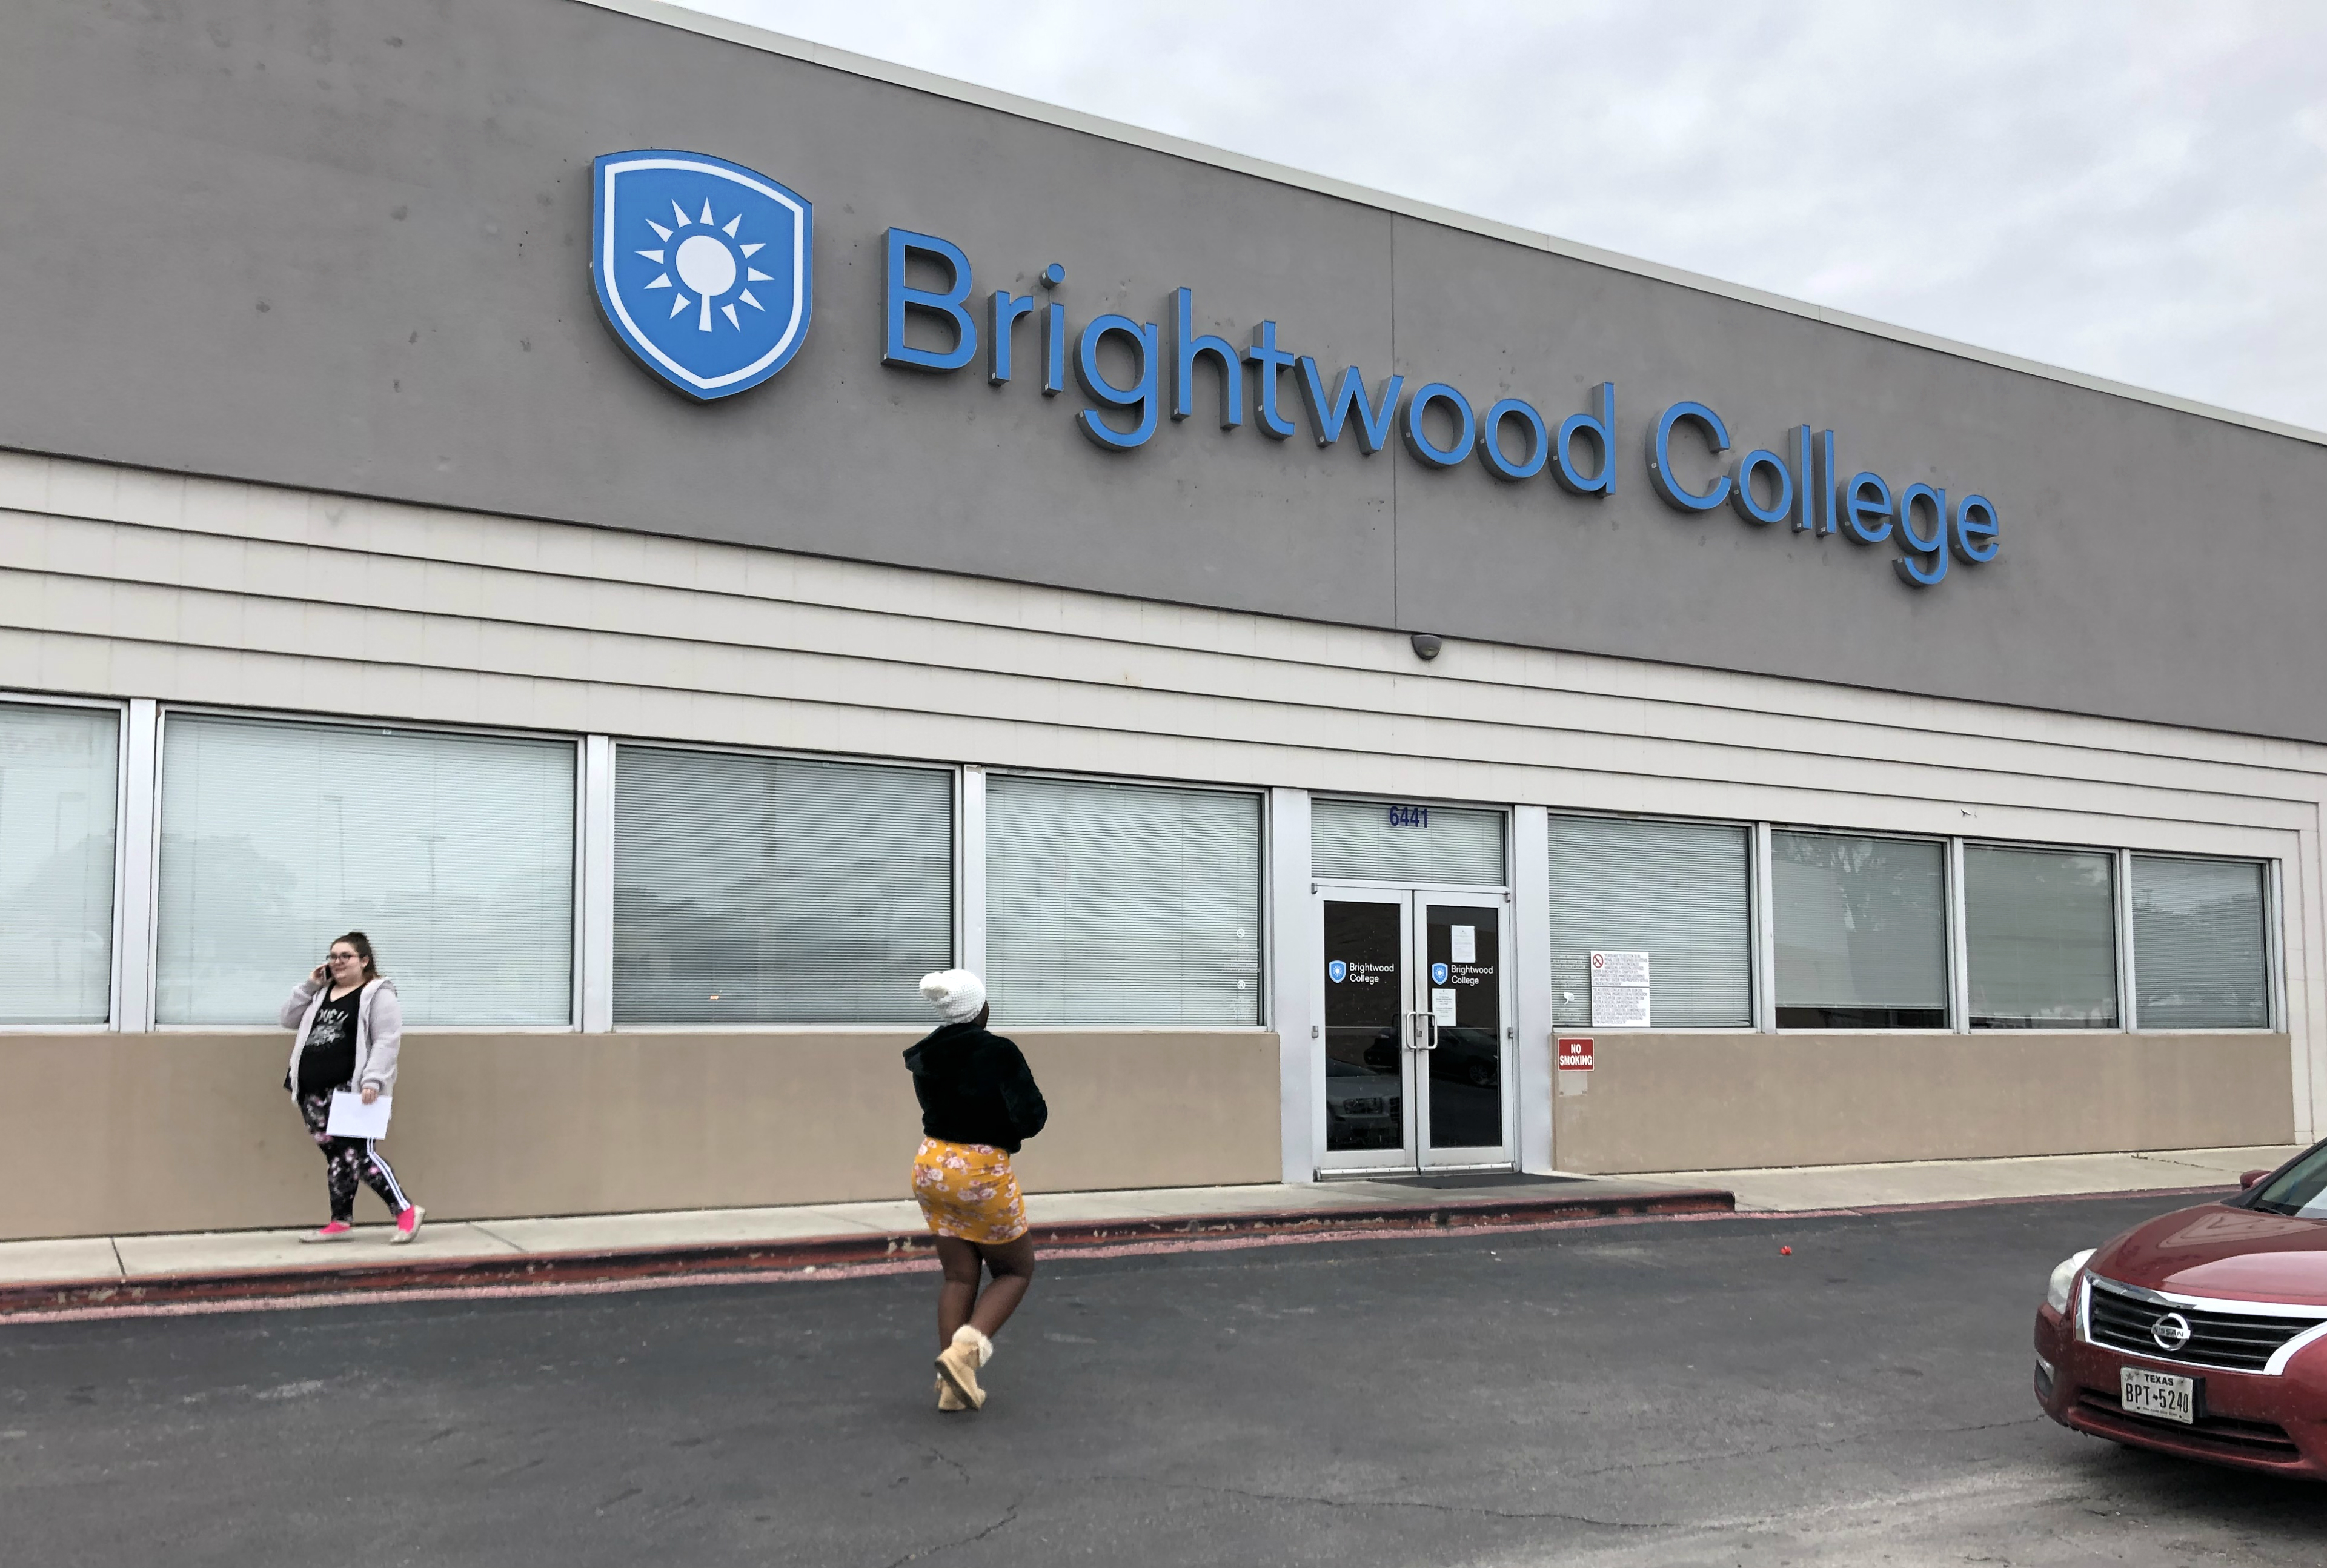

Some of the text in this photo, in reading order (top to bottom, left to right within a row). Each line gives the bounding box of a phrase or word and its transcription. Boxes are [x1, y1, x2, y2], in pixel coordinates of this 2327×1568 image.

[881, 227, 2000, 586] Brightwood College
[1390, 806, 1427, 828] 6441
[1349, 962, 1395, 974] Brightwood
[1451, 965, 1493, 976] Brightwood
[1349, 973, 1379, 985] College
[1451, 975, 1479, 986] College
[1570, 1043, 1581, 1054] NO
[1559, 1055, 1592, 1066] SMOKING
[2153, 1326, 2184, 1338] NISSAN
[2144, 1374, 2174, 1386] TEXAS
[2126, 1383, 2150, 1406] BPT
